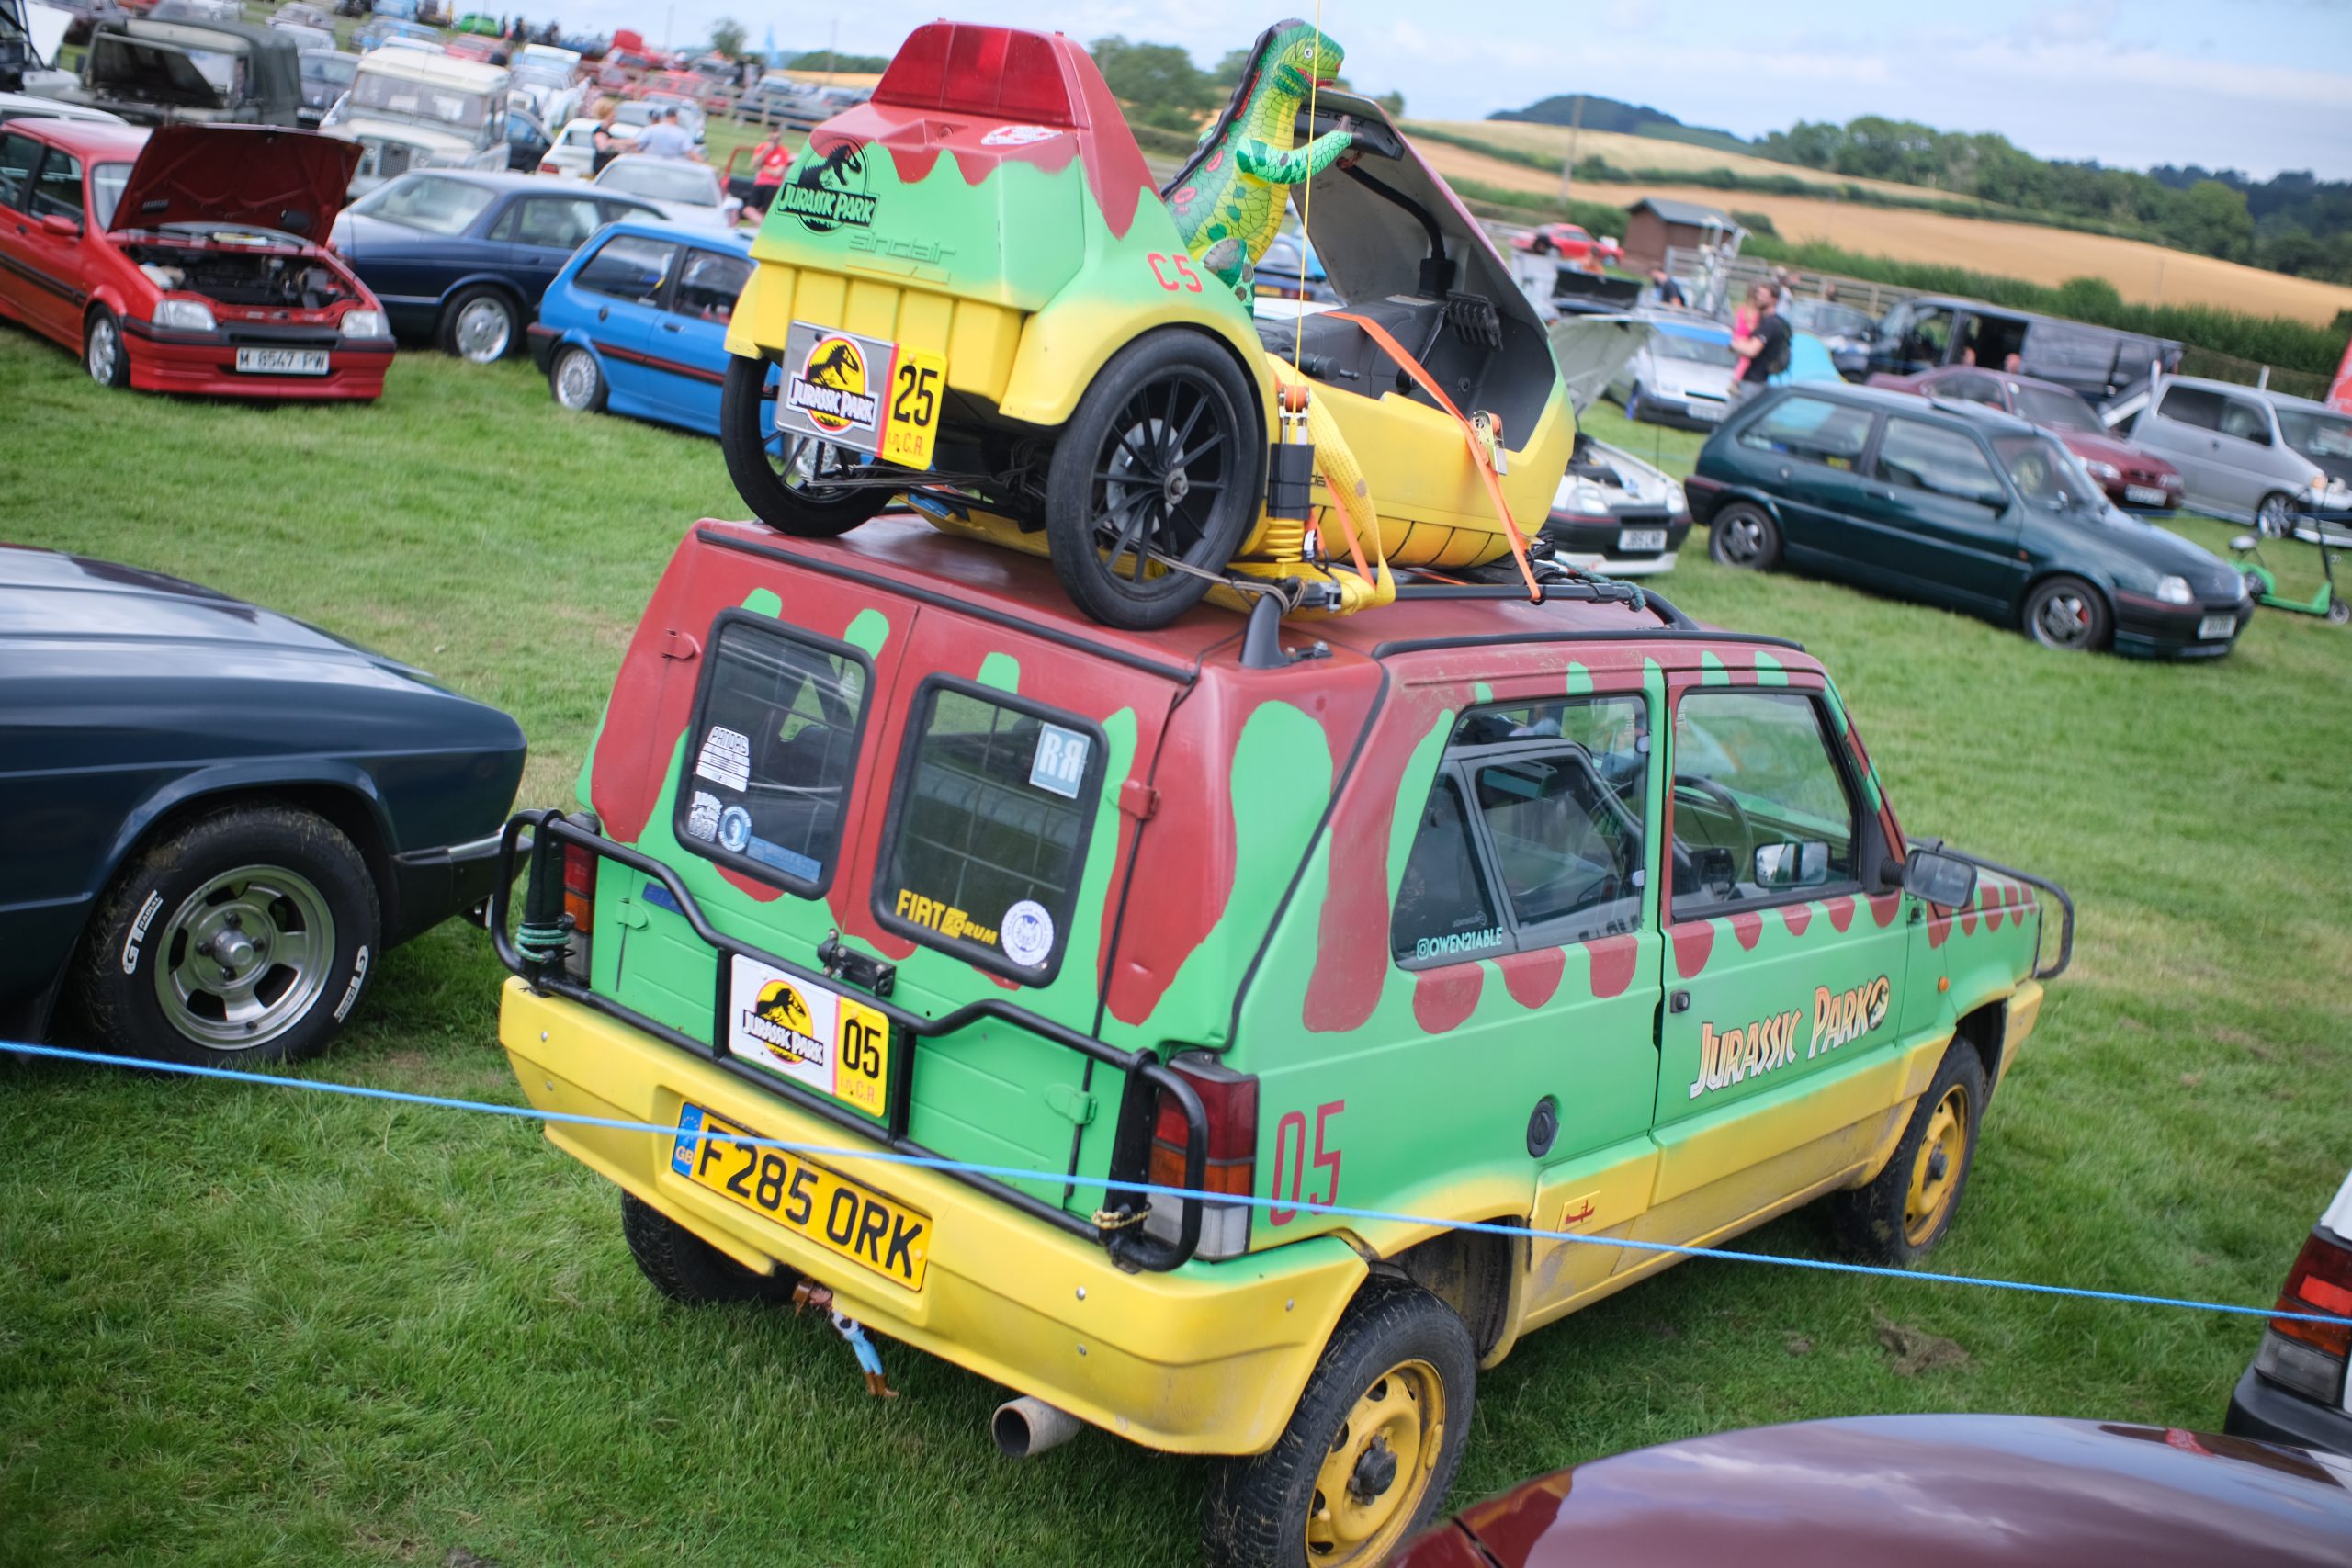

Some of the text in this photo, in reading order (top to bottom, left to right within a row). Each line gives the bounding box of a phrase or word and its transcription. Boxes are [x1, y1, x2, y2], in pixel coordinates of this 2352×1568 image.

[779, 184, 875, 223] JURASSIC PARK
[848, 229, 956, 265] sinclair
[1146, 252, 1204, 293] C5
[788, 378, 875, 423] JURASSIC PARK
[893, 364, 939, 428] 25
[139, 896, 163, 930] RADIAL
[895, 888, 946, 931] FIAT
[944, 910, 999, 946] FORUM
[742, 1010, 824, 1065] JURASSIC PARK
[843, 1018, 882, 1080] 05
[1689, 978, 1876, 1100] JURASSIC PARK
[674, 1145, 695, 1166] GB
[1270, 1099, 1345, 1227] 05
[698, 1123, 923, 1280] F285 ORK
